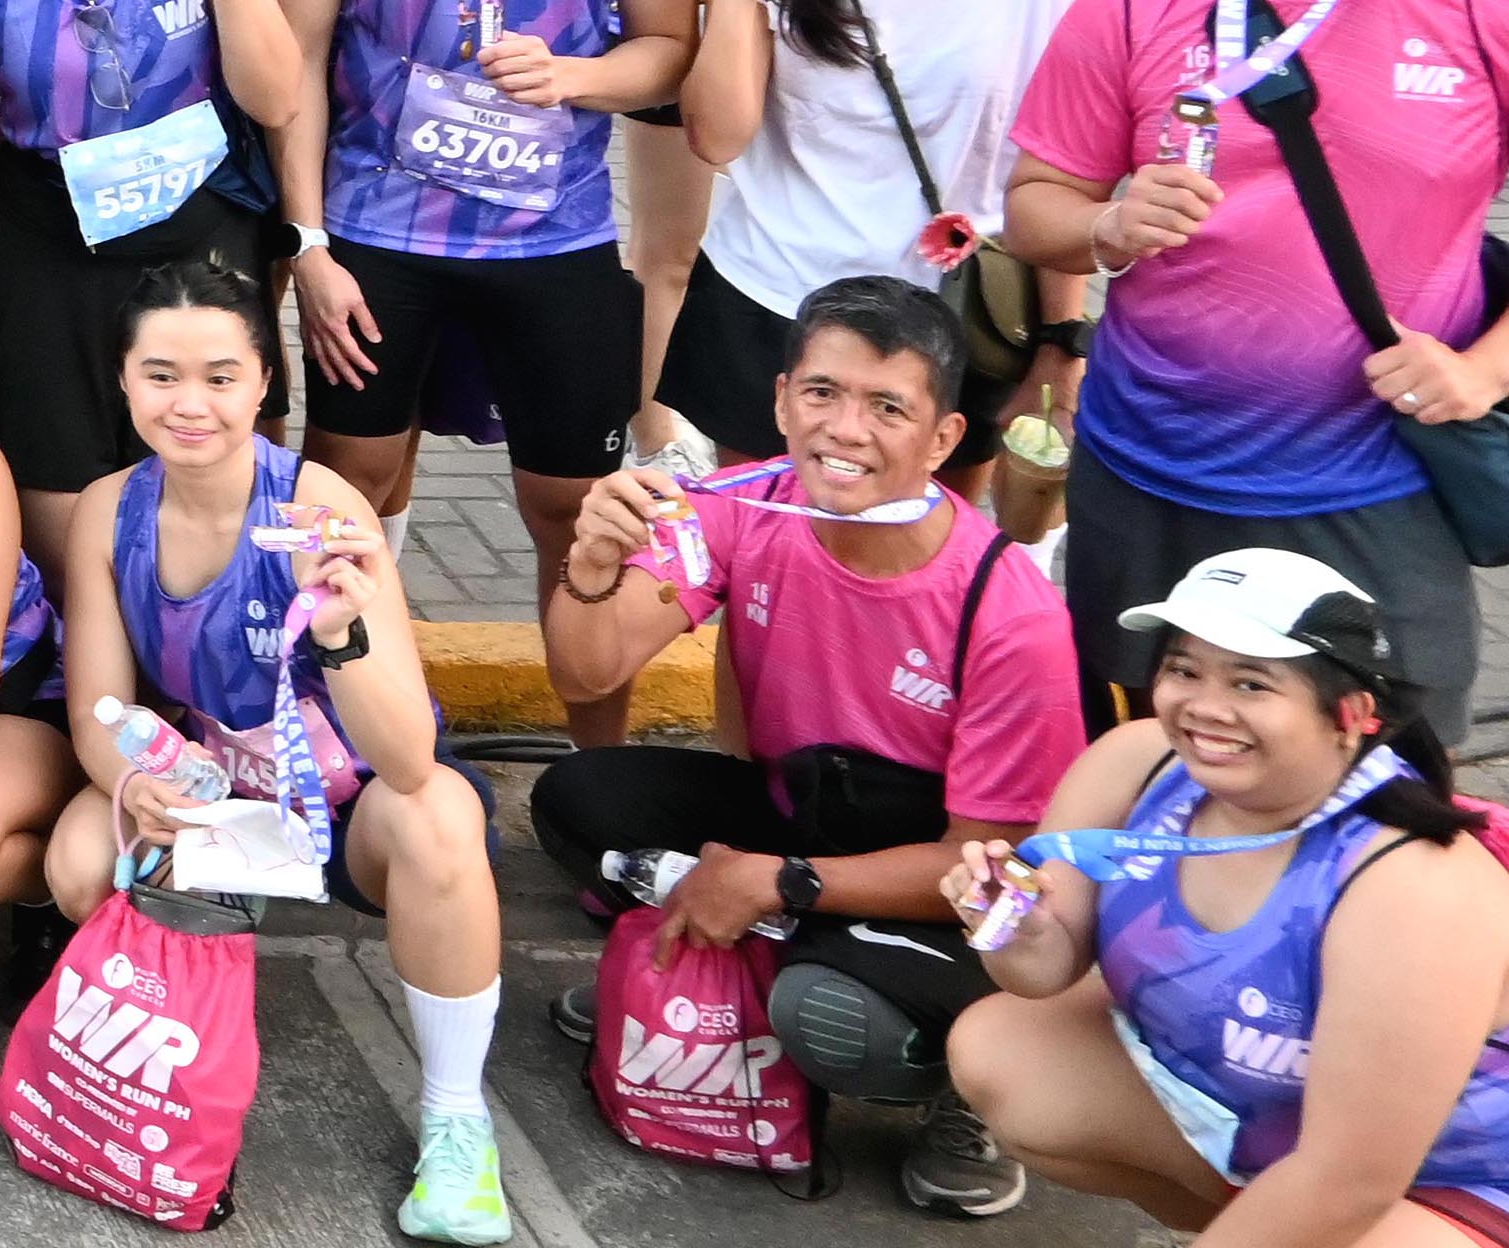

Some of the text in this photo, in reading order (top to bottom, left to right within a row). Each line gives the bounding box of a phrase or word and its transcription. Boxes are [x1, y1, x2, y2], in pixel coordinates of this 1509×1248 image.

[1185, 45, 1210, 68] 16
[1394, 62, 1465, 95] WR
[472, 109, 512, 129] 16KM
[412, 119, 542, 174] 63704
[93, 159, 206, 221] 55797
[750, 582, 769, 606] 16
[890, 665, 953, 709] WR
[132, 977, 168, 1000] CEO
[53, 965, 200, 1094] WR
[699, 1011, 738, 1029] CEO
[618, 1014, 783, 1099] WR
[48, 1033, 191, 1121] WOMEN'S RUN PH
[615, 1078, 710, 1105] WOMEN'S
